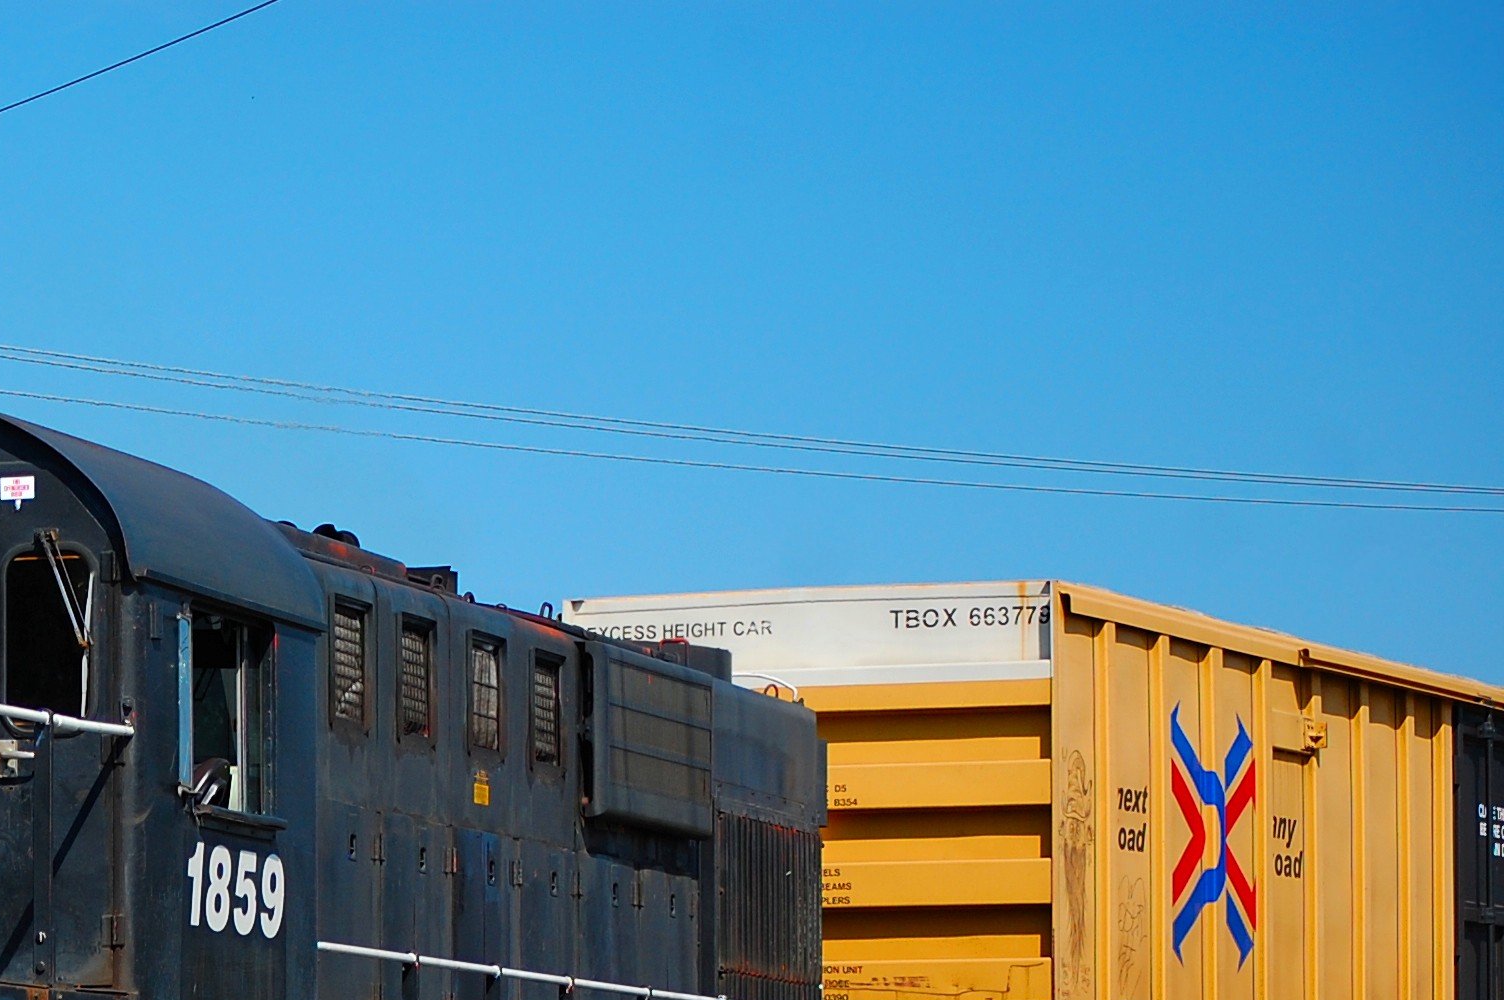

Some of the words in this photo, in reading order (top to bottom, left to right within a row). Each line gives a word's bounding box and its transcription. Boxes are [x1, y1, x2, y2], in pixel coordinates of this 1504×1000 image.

[890, 608, 957, 629] TBOX
[969, 605, 1051, 627] 663779
[663, 622, 726, 640] HEIGHT
[733, 620, 773, 637] CAR
[1117, 822, 1147, 853] oad
[823, 868, 841, 877] ELS
[1272, 850, 1303, 879] oad
[187, 841, 285, 939] 1859
[842, 965, 863, 974] UNIT
